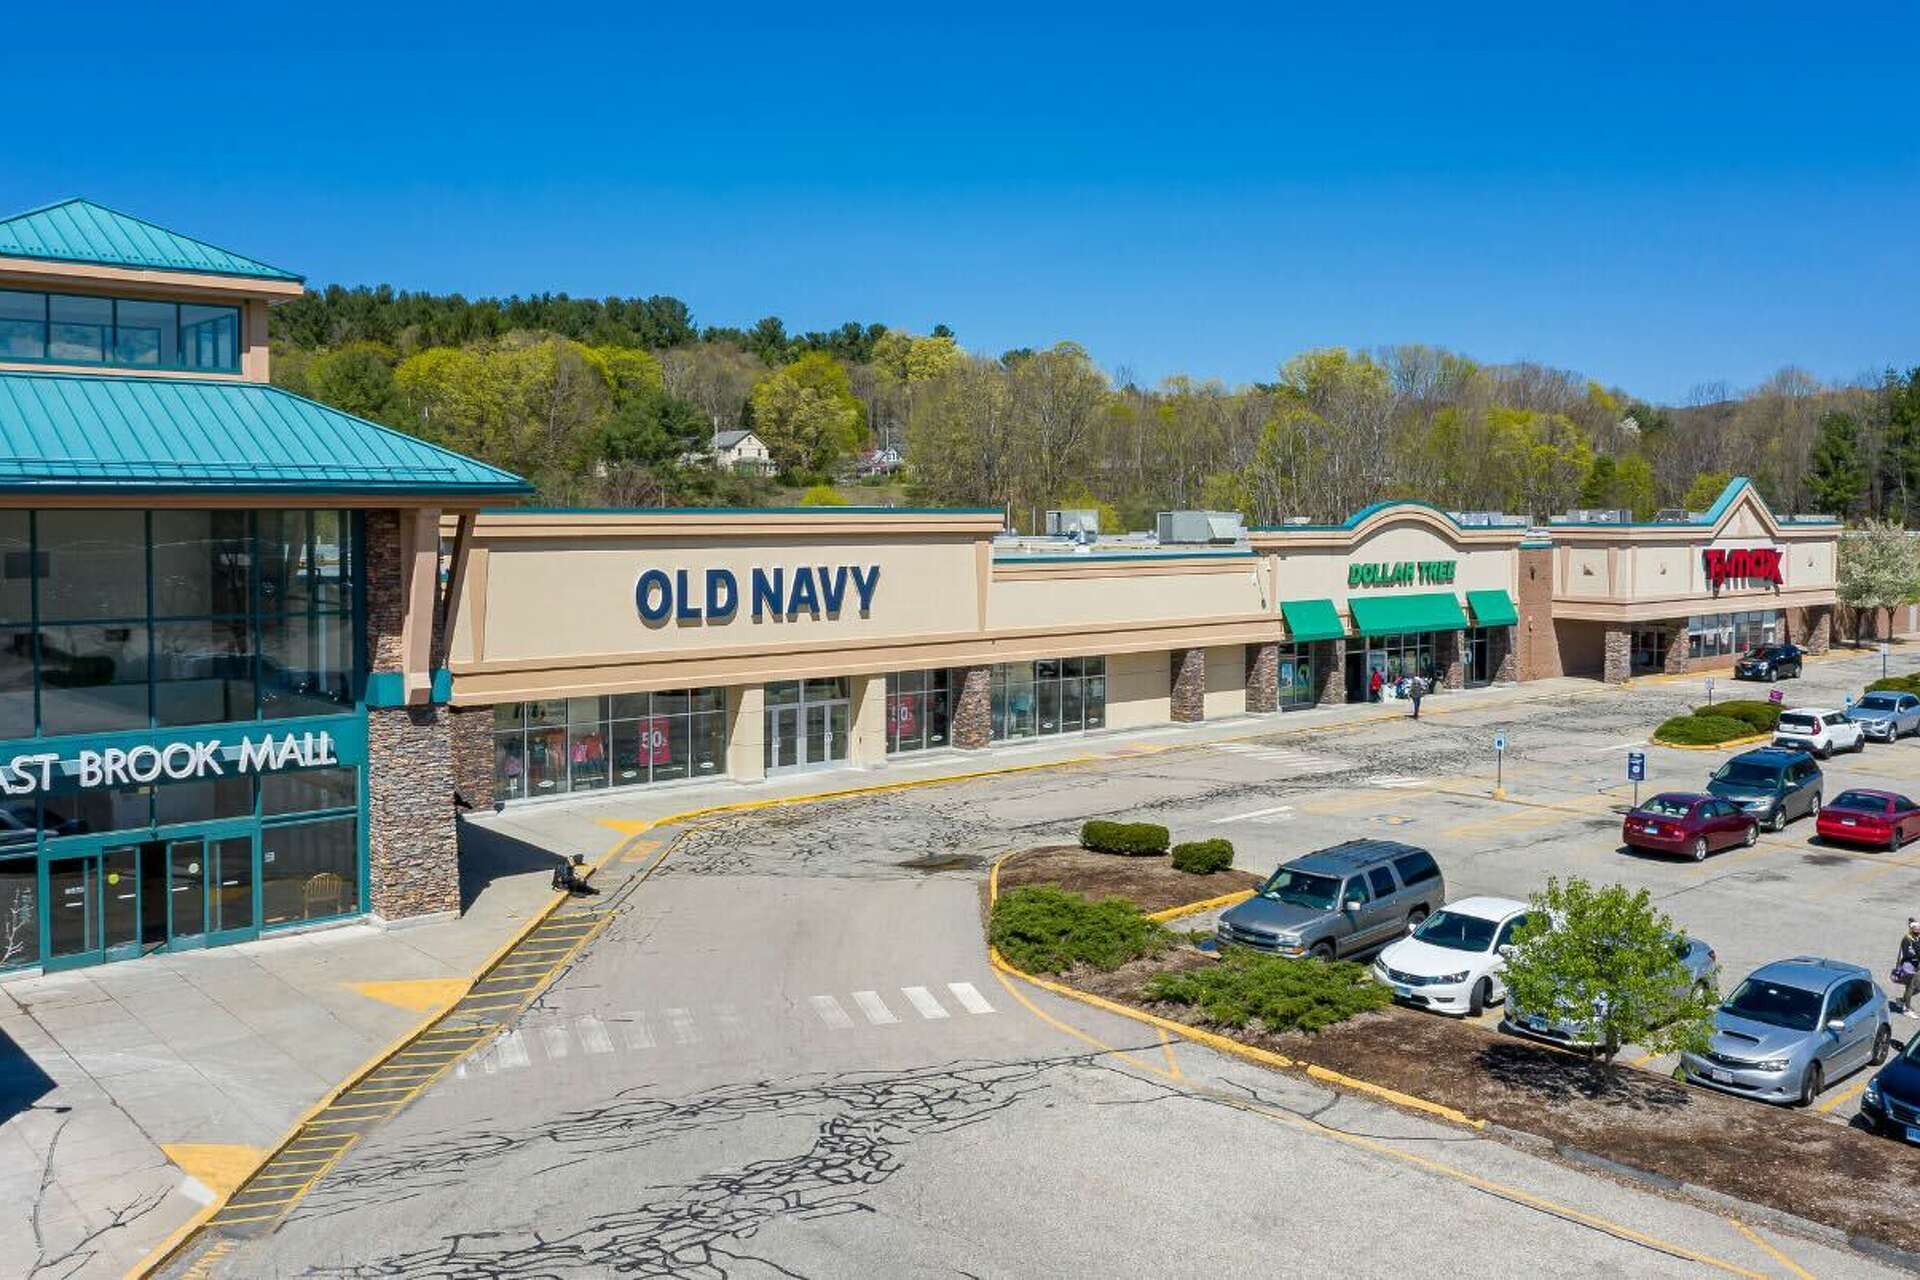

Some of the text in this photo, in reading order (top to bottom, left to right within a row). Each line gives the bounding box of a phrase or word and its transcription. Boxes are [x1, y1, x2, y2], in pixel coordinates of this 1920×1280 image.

[635, 565, 881, 627] OLD NAVY
[1349, 560, 1457, 586] DOLLAR TREE
[79, 740, 224, 787] BROOK
[238, 731, 337, 773] MALL
